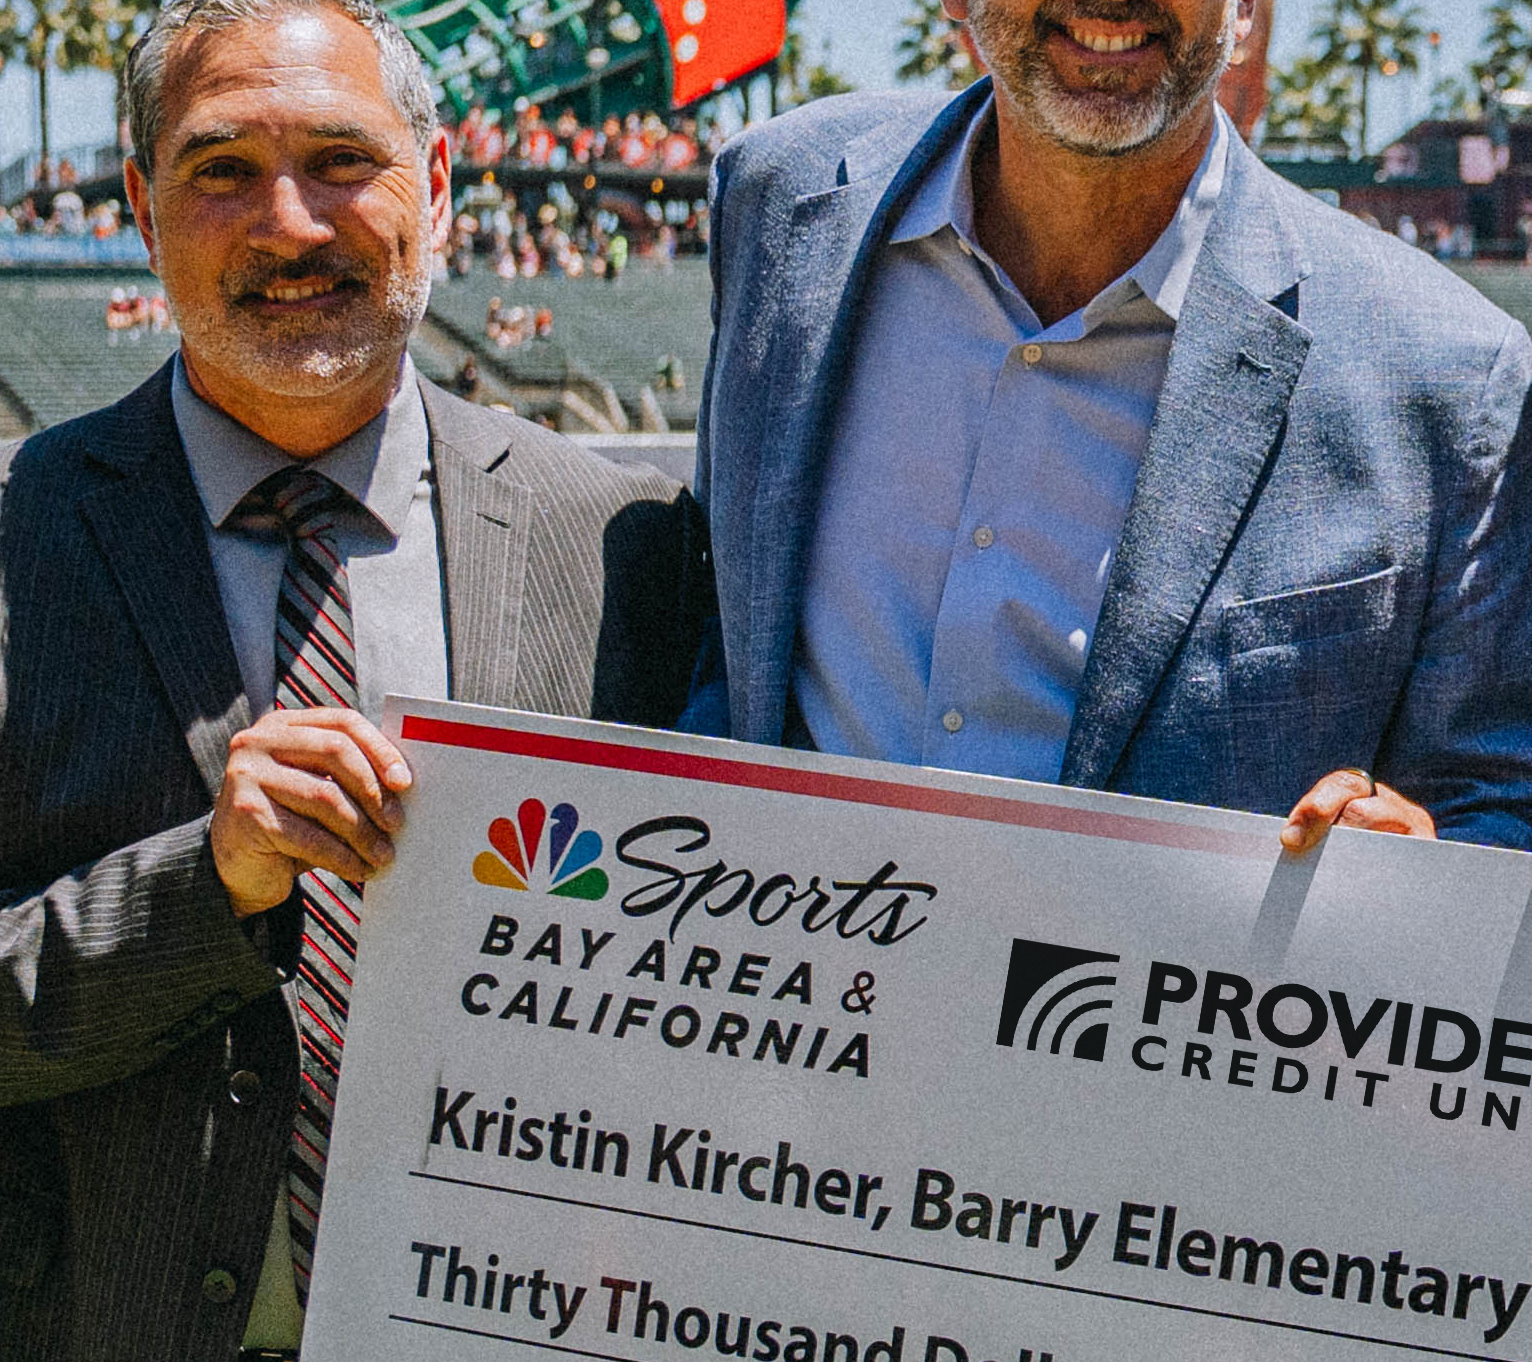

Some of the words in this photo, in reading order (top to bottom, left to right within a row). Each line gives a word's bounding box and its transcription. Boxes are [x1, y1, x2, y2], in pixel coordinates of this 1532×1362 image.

[615, 816, 938, 944] Sports
[479, 914, 616, 971] BAY
[626, 938, 813, 1006] AREA
[840, 970, 878, 1016] &
[461, 972, 871, 1079] CALIFORNIA
[1130, 1034, 1391, 1109] CREDIT
[429, 1085, 629, 1177] Kristin
[646, 1122, 893, 1232] Kircher,
[908, 1167, 1100, 1271] Barry
[1110, 1200, 1532, 1343] Elementary
[410, 1240, 588, 1340] Thirty
